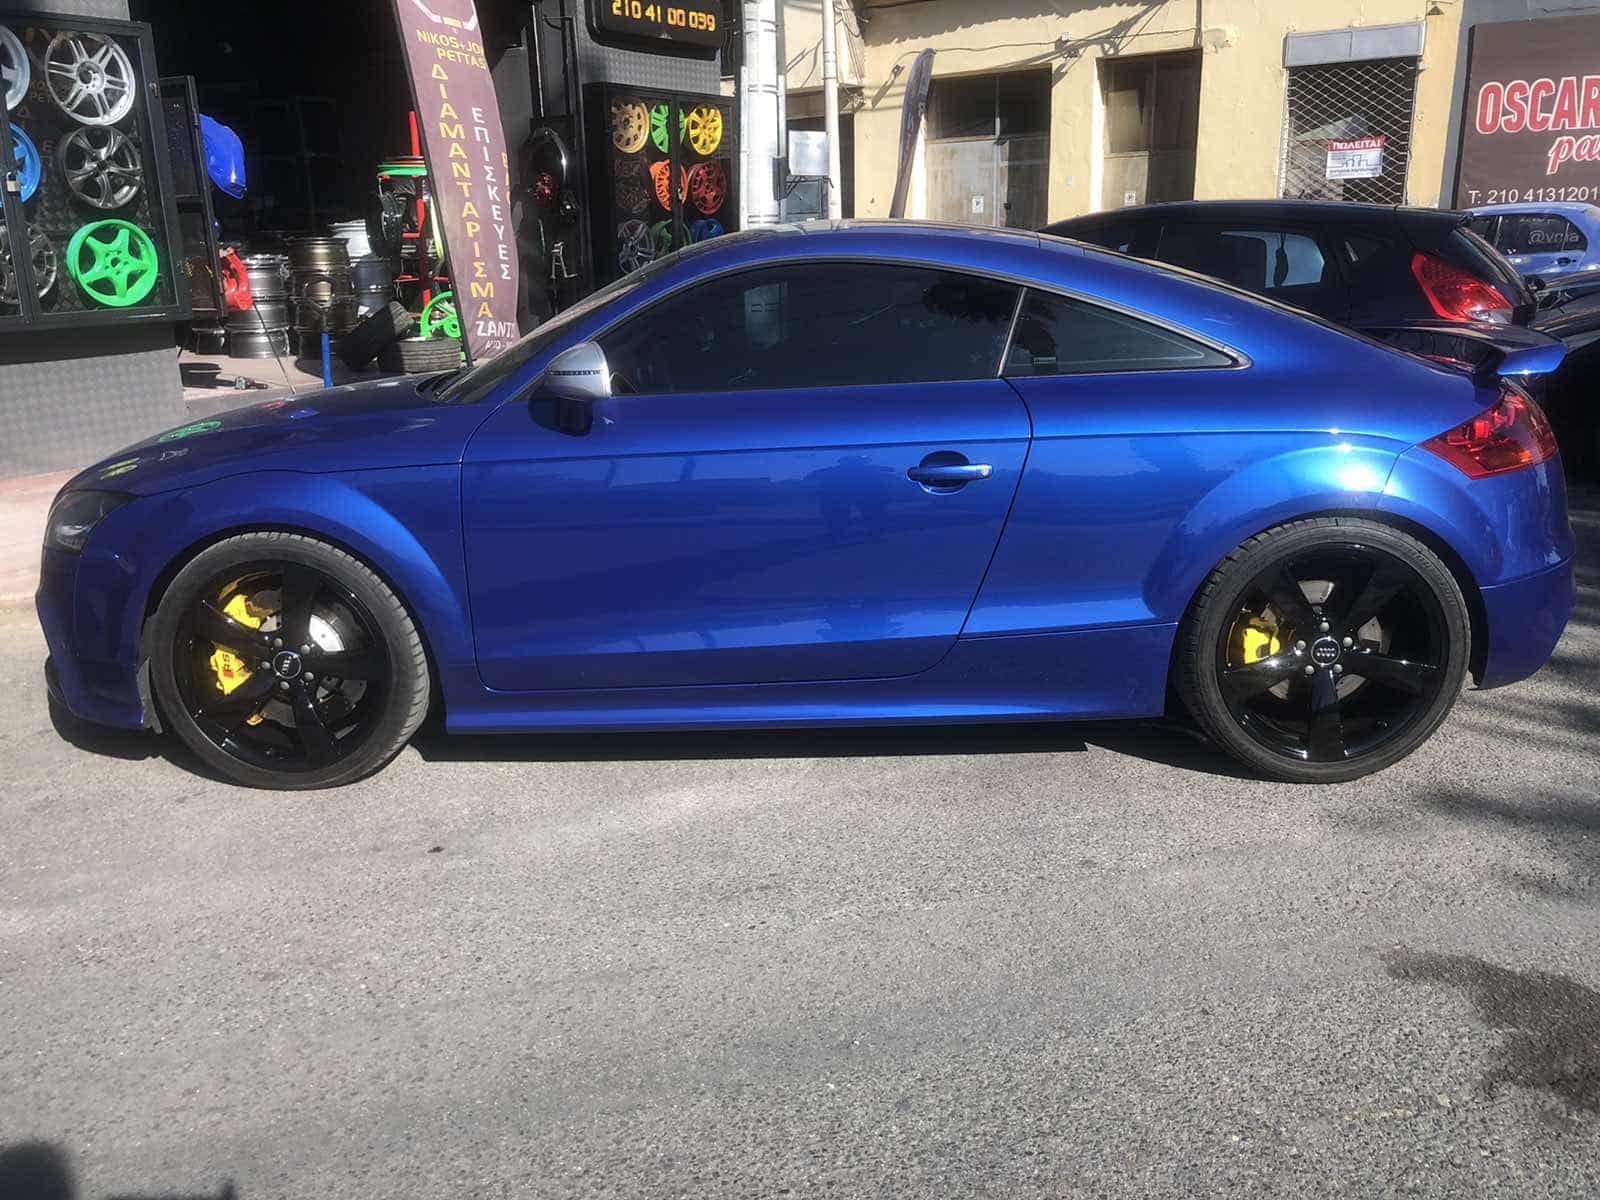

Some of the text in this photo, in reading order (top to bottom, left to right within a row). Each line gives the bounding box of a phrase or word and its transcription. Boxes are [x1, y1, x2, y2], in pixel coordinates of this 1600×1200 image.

[612, 0, 716, 32] 210 41 00 039
[471, 106, 512, 281] ΕΠΙΣΚΕΥΕΣ
[1468, 185, 1600, 205] T: 210 4131201
